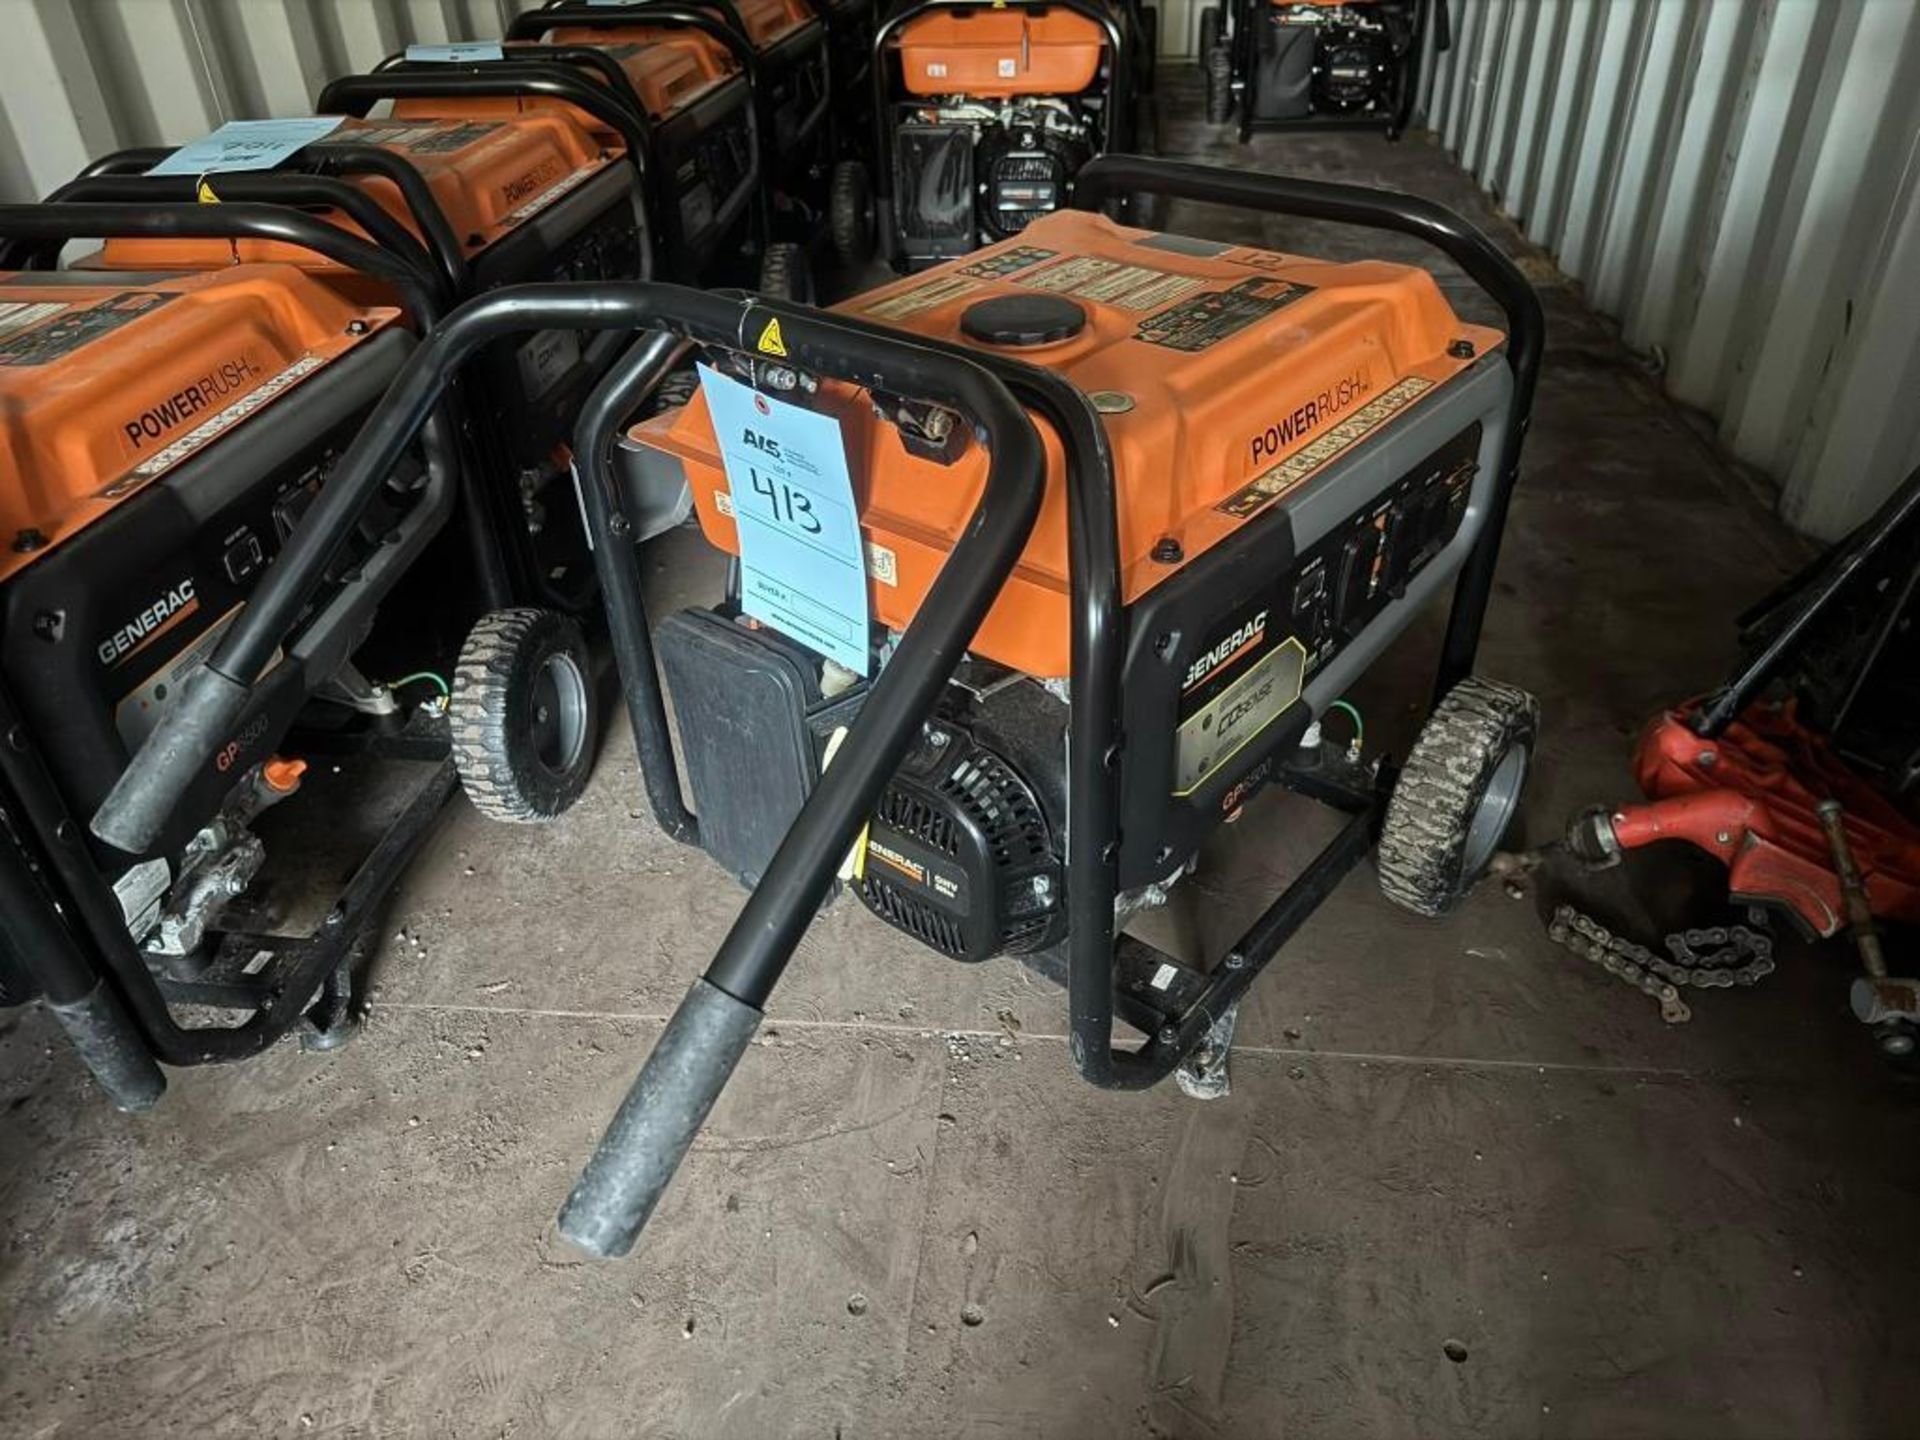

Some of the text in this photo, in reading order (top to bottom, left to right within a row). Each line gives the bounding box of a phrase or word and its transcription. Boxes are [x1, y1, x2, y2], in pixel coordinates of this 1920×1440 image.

[124, 357, 253, 449] POWERRUSH
[1250, 373, 1364, 465] POWERRUSH
[743, 428, 781, 460] AIS
[750, 467, 822, 535] 413
[98, 579, 196, 665] GENERAC
[868, 840, 925, 875] ENERAC
